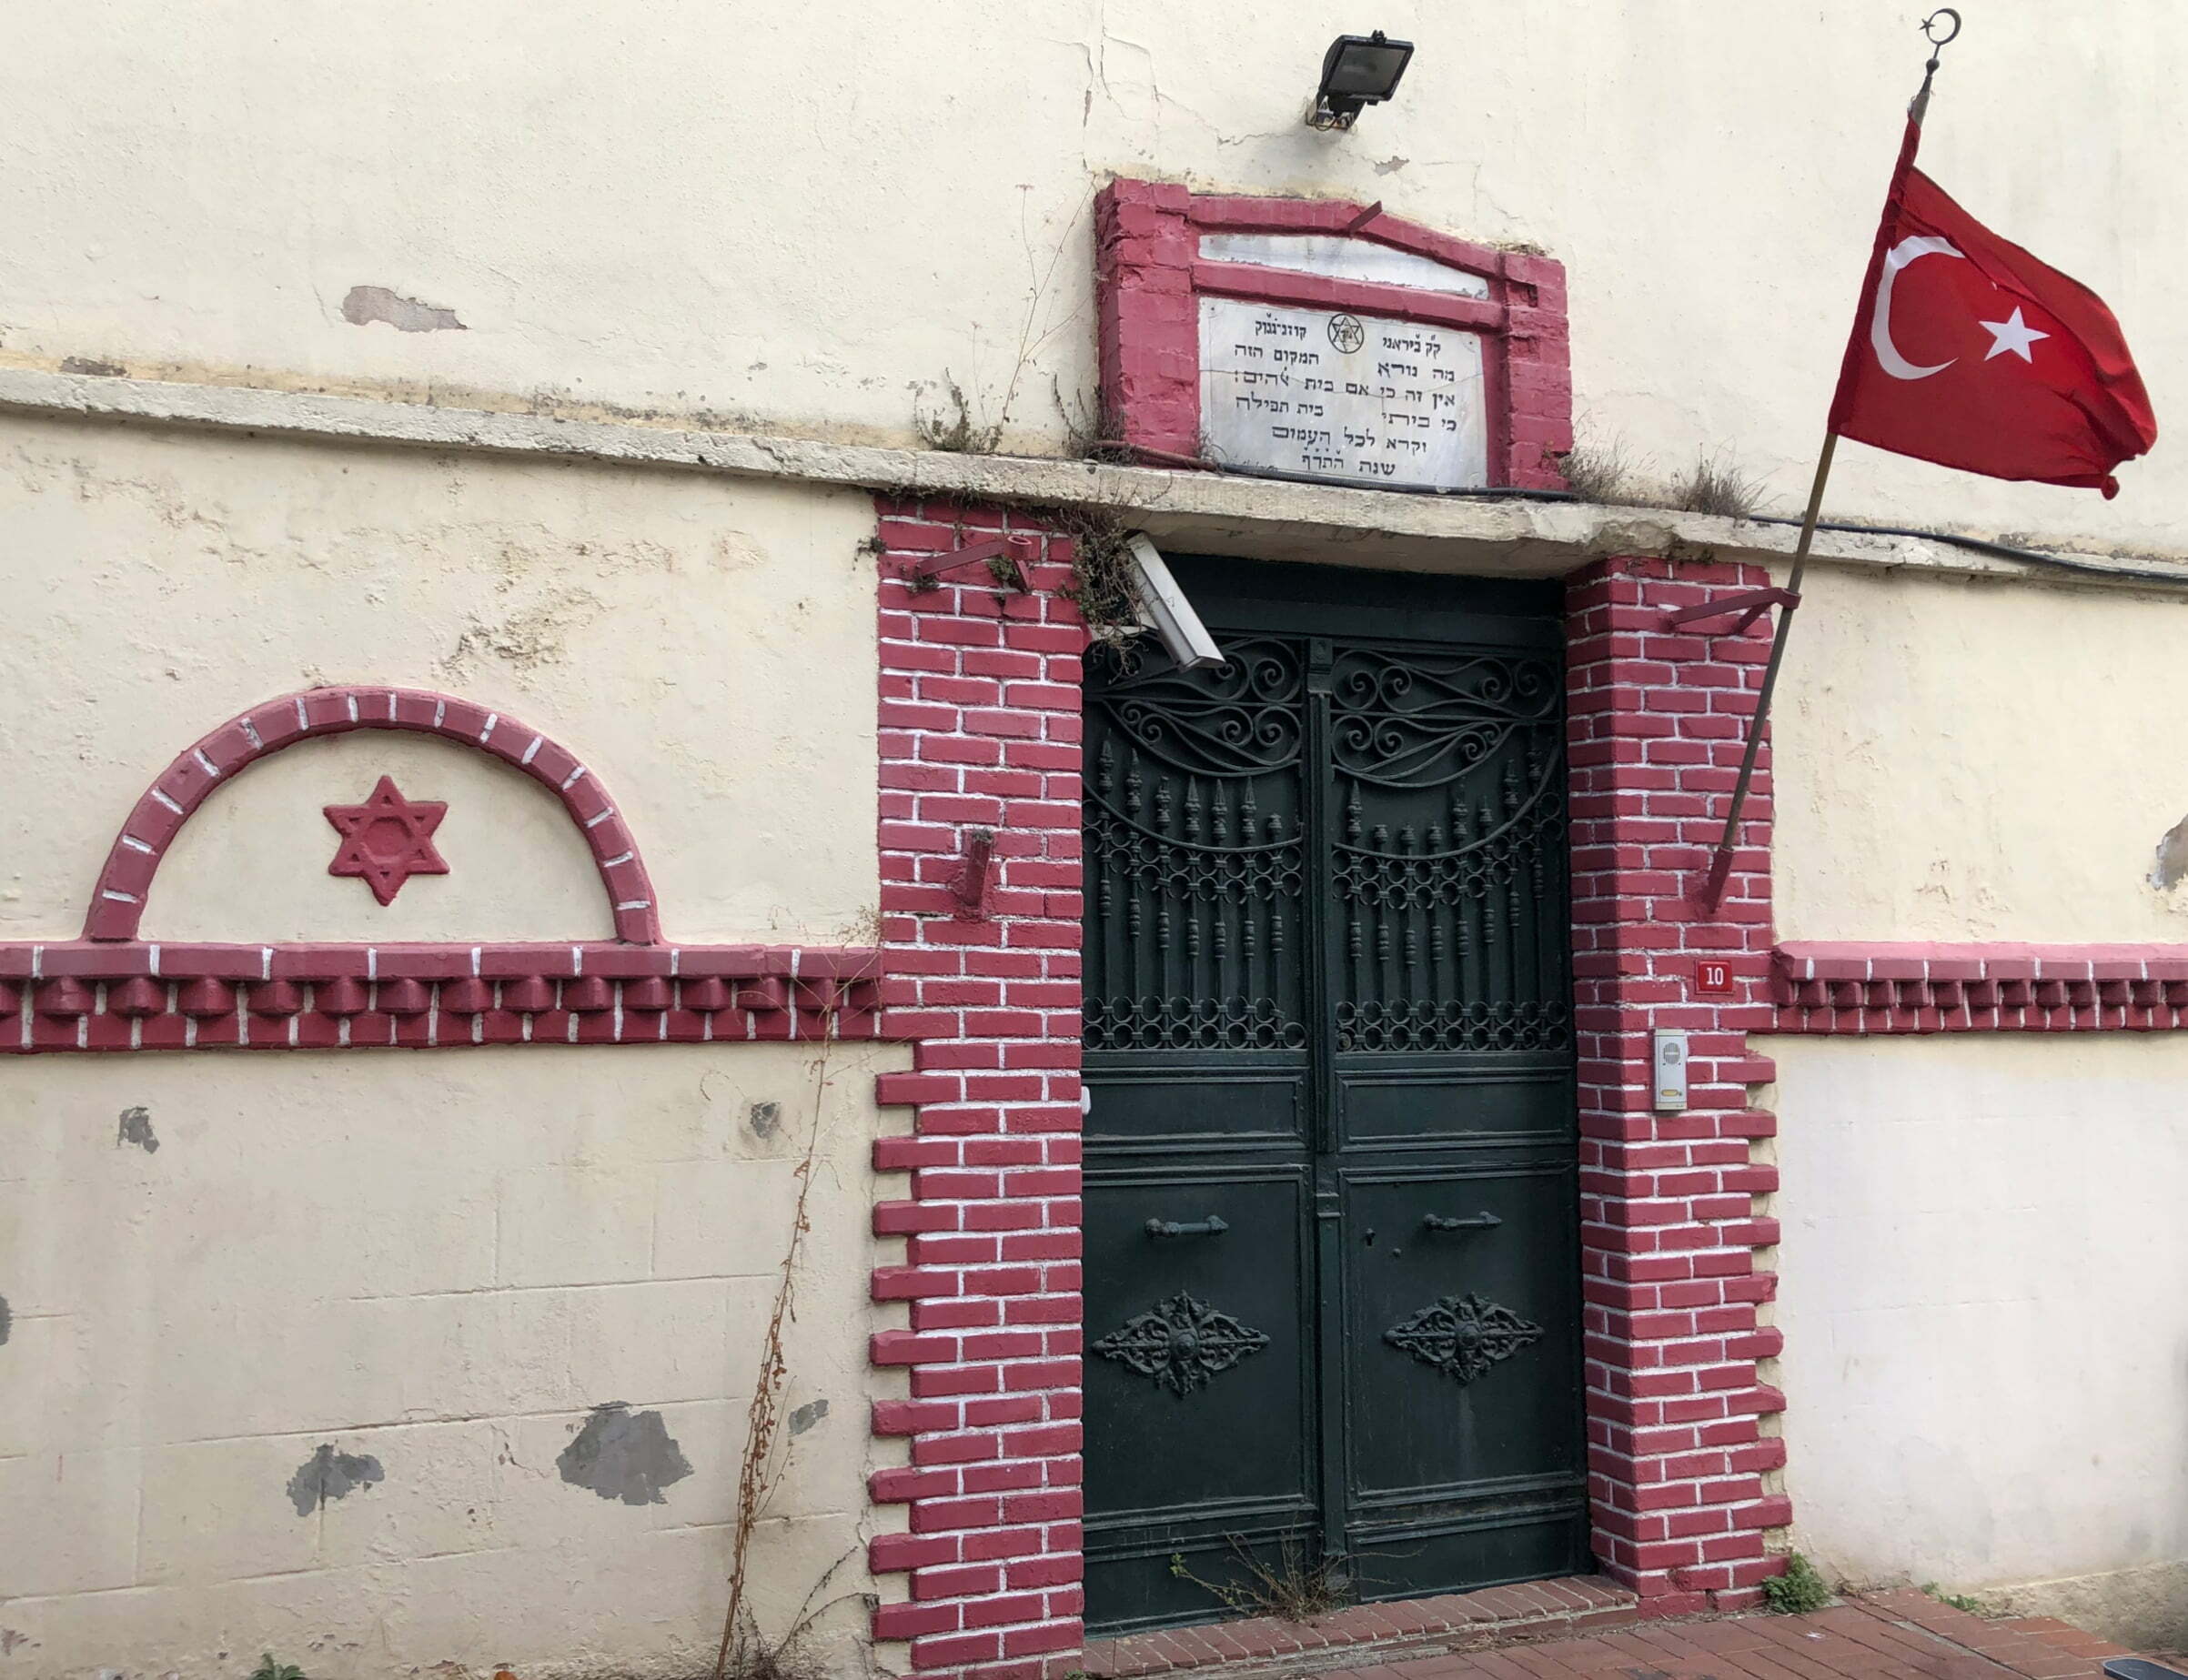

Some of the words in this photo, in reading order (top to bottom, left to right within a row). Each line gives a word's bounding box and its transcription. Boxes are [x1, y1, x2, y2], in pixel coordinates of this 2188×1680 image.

[1235, 344, 1263, 358] הזה
[1274, 348, 1319, 365] המקום
[1376, 362, 1418, 378] נורא
[1432, 368, 1456, 382] מה
[1304, 377, 1335, 392] בית
[1346, 382, 1369, 397] אם
[1380, 387, 1396, 398] כי
[1405, 389, 1423, 403] זה
[1235, 391, 1289, 411] תפילה
[1432, 393, 1456, 410] אין
[1296, 403, 1325, 417] בית
[1381, 412, 1430, 428] ביתי
[1441, 418, 1457, 432] כי
[1344, 426, 1376, 448] לכל
[1706, 967, 1724, 986] 10
